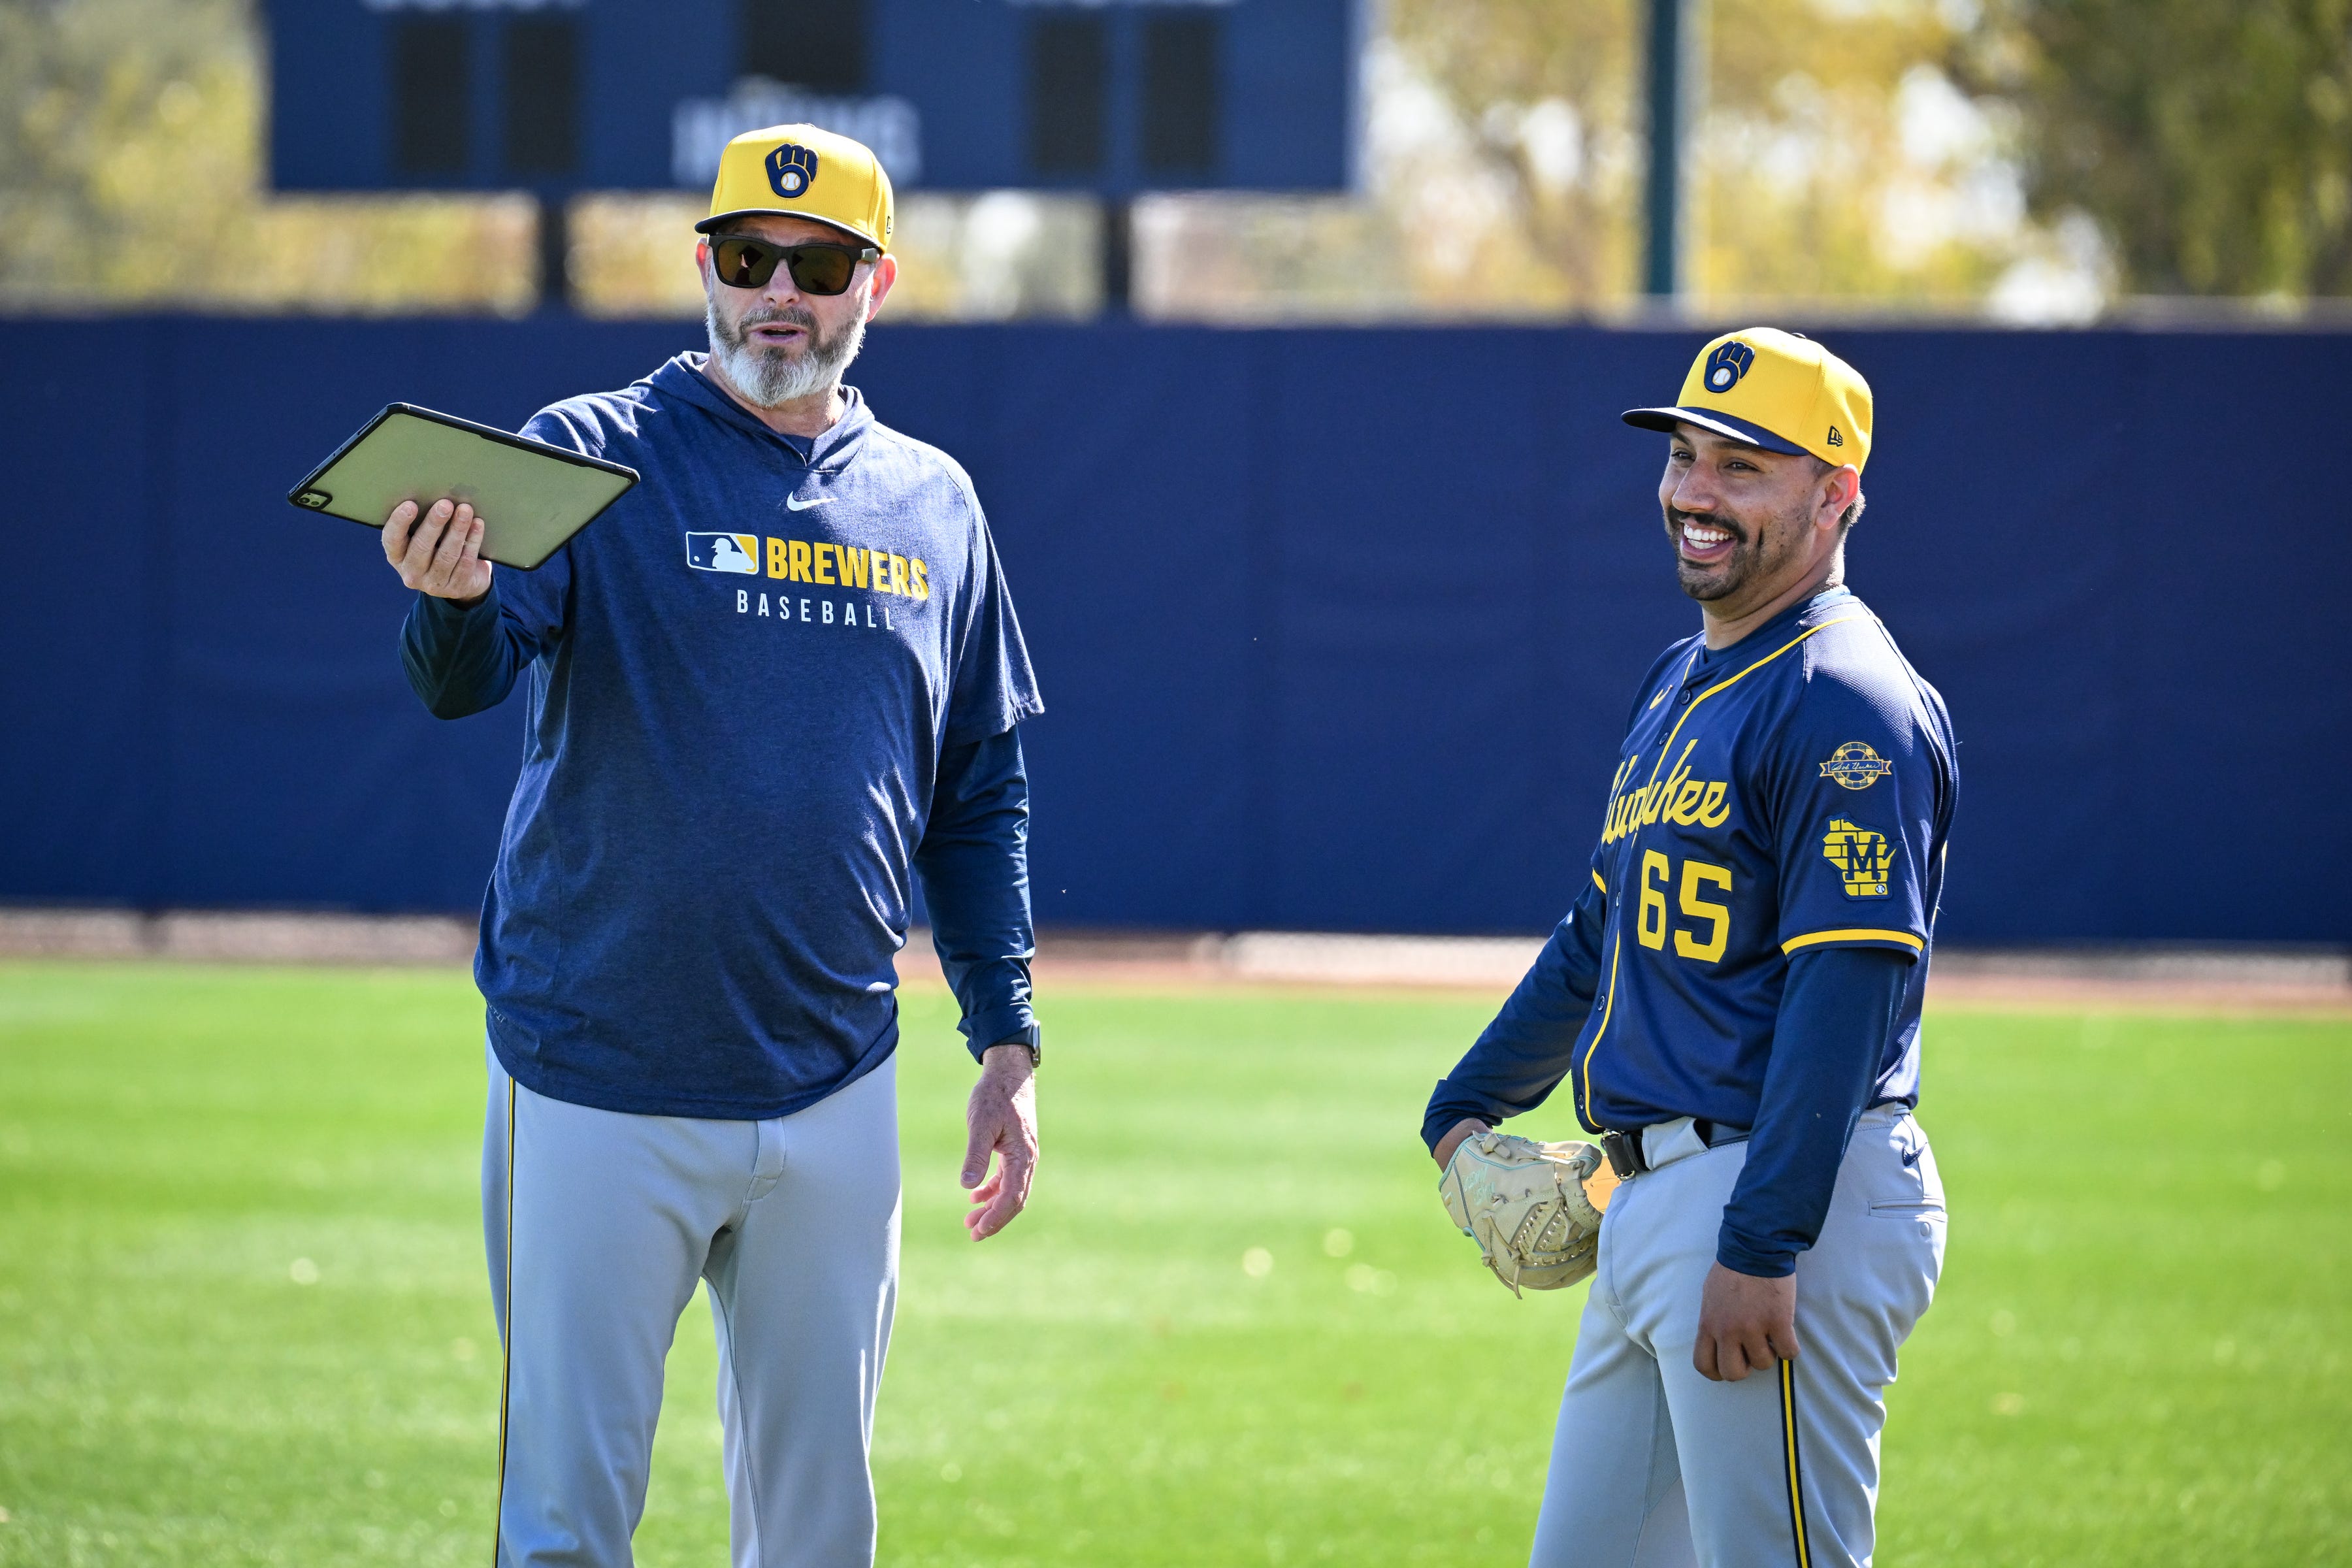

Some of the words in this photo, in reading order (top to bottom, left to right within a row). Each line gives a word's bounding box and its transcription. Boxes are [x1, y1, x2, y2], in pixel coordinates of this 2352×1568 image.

[766, 536, 929, 601] BREWERS
[737, 589, 895, 630] BASEBALL
[1844, 835, 1881, 880] M
[1637, 849, 1731, 963] 65
